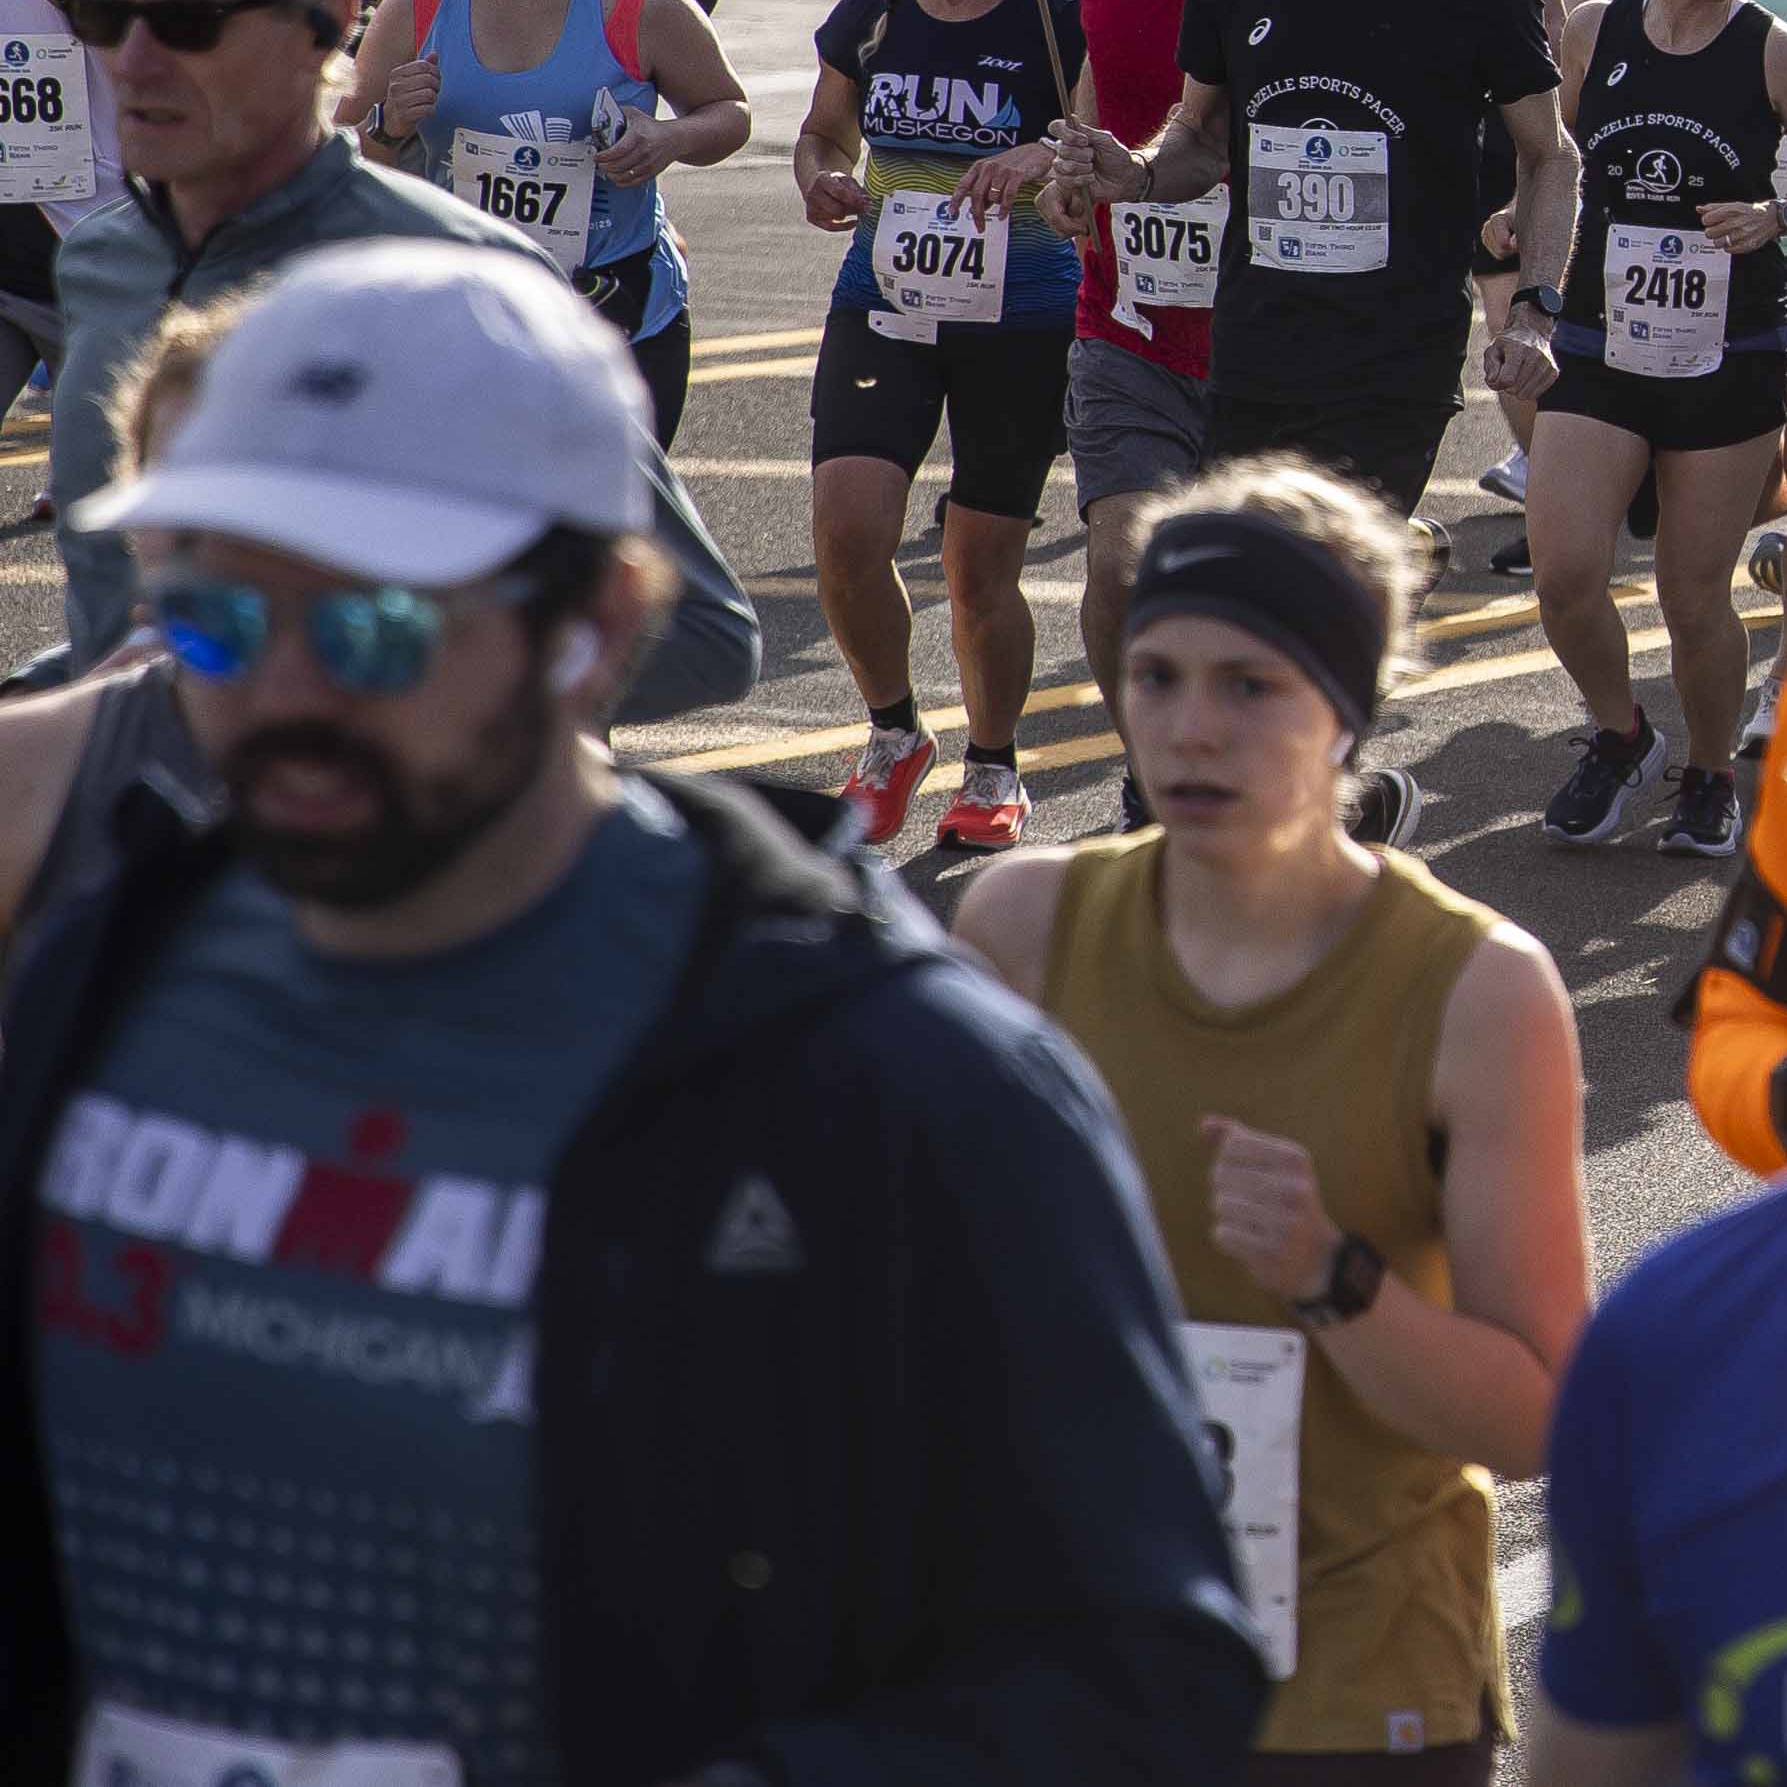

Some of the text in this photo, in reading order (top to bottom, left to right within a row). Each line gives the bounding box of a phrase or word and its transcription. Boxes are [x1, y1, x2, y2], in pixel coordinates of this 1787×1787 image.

[864, 73, 999, 126] RUN
[1246, 76, 1406, 135] GAZELLE SPORTS PACER
[863, 115, 1018, 147] MUSKEGON
[1587, 113, 1741, 171] GAZELLE SPORTS PACER
[1607, 165, 1623, 176] 20
[1687, 176, 1705, 187] 25
[476, 172, 568, 226] 1667
[1277, 172, 1355, 221] 390
[892, 231, 985, 280] 3074
[1124, 212, 1211, 265] 3075
[1625, 265, 1708, 310] 2418
